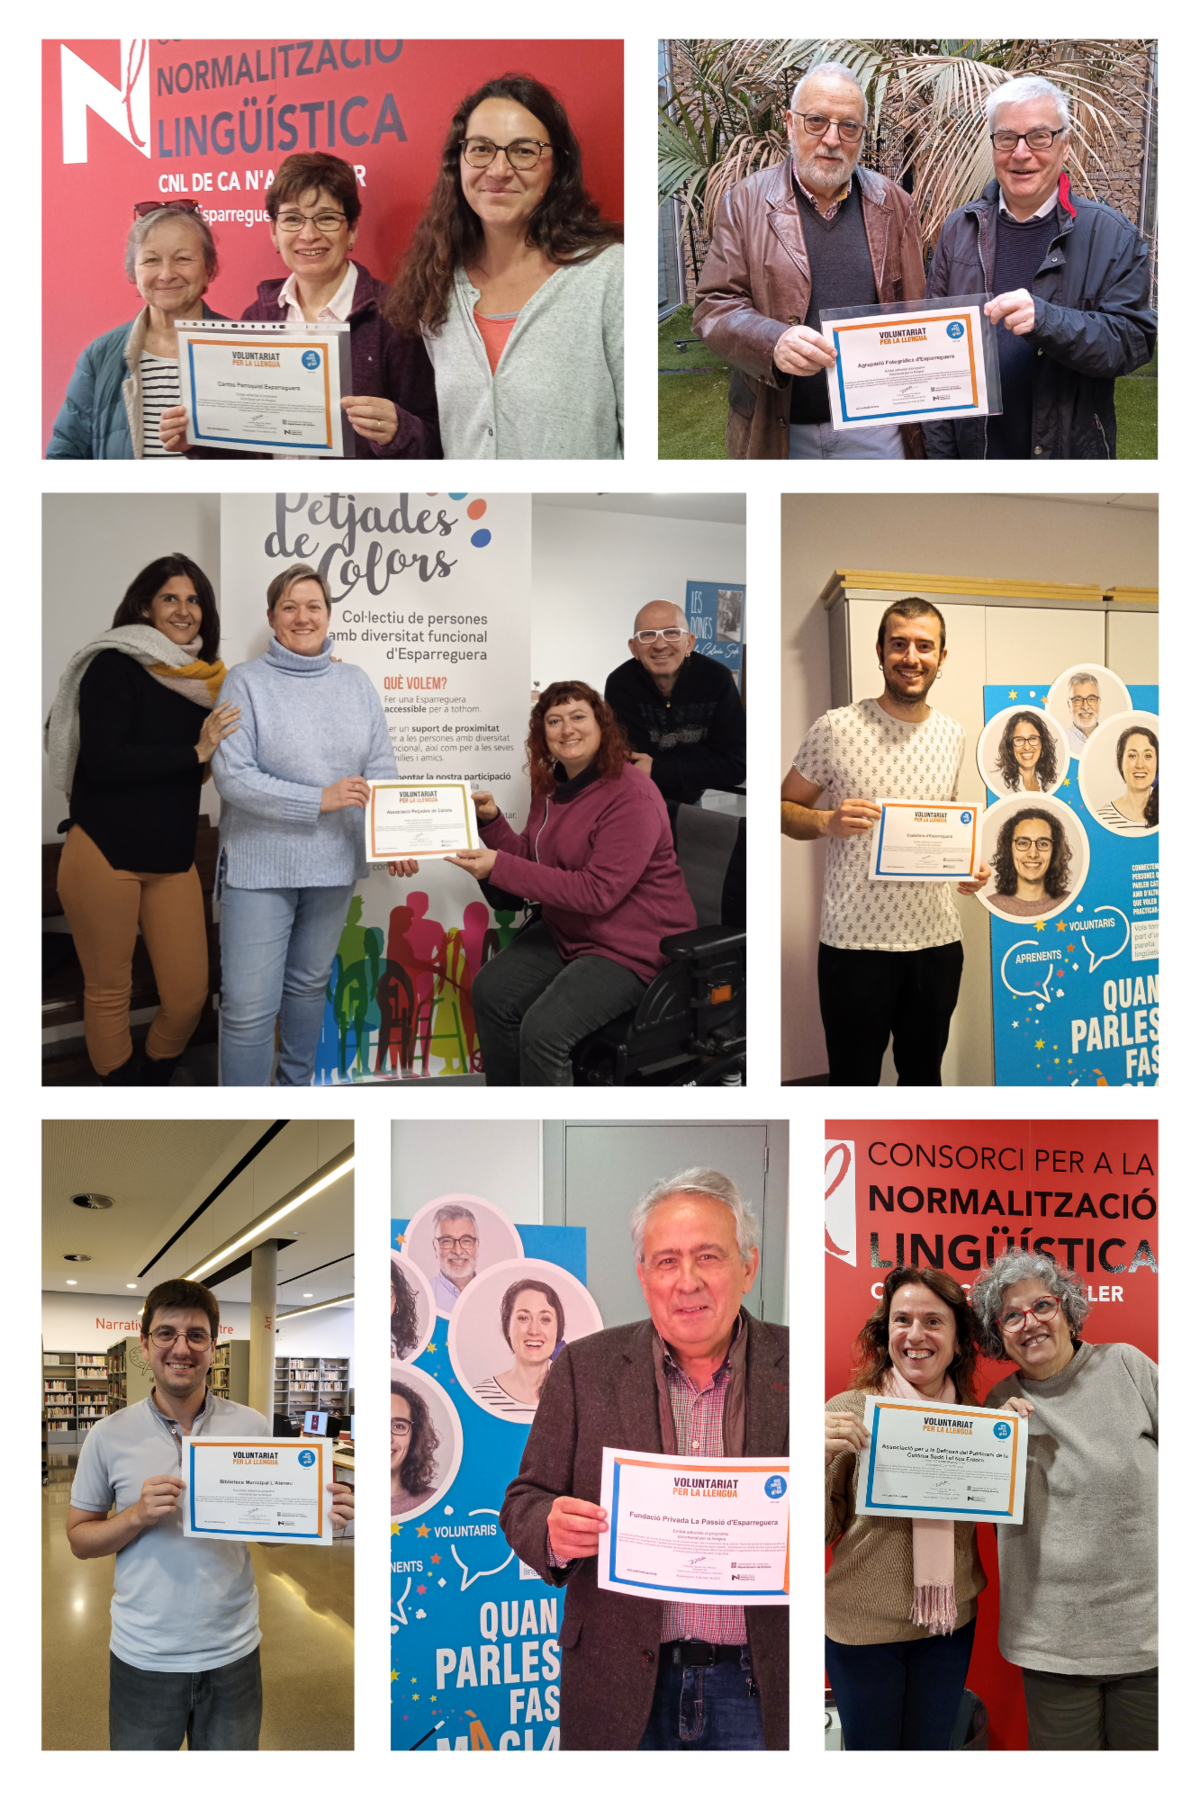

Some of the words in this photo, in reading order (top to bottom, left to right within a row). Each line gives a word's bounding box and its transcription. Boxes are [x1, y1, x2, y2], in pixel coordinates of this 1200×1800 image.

[158, 93, 408, 158] LINGÜÍSTICA
[158, 174, 188, 193] CNL
[192, 172, 213, 192] DE
[217, 171, 241, 192] CA
[879, 328, 927, 339] VOLUNTARIAT
[902, 335, 928, 343] LLENGUA
[232, 351, 280, 361] VOLUNTARIAT
[264, 531, 319, 559] de
[314, 541, 458, 603] Colors
[342, 610, 404, 625] Col·lectiu
[408, 612, 424, 624] de
[428, 613, 488, 628] persones
[328, 630, 357, 642] amb
[361, 630, 424, 643] diversitat
[428, 631, 488, 643] funcional
[386, 648, 488, 664] d'Esparreguera
[384, 675, 404, 690] QUÈ
[407, 677, 448, 690] VOLEM?
[384, 695, 396, 703] Fer
[416, 696, 467, 705] Esparreguera
[384, 705, 427, 713] accessible
[451, 705, 482, 713] tothom.
[411, 725, 440, 735] suport
[442, 725, 453, 733] de
[455, 725, 500, 735] proximitat
[406, 734, 417, 742] les
[419, 736, 454, 744] persones
[456, 734, 473, 742] amb
[475, 733, 510, 742] diversitat
[425, 744, 439, 752] així
[459, 746, 472, 754] per
[464, 772, 512, 781] participació
[1132, 872, 1155, 880] PERSONES
[1132, 881, 1150, 889] PARLEN
[1133, 899, 1142, 907] QUE
[1143, 898, 1157, 906] VOLEN
[1069, 918, 1115, 932] VOLUNTARIS
[1134, 933, 1146, 941] part
[1134, 941, 1155, 950] parella
[1015, 950, 1062, 964] APRENENTS
[1071, 1007, 1159, 1054] PARLES
[1126, 1044, 1159, 1079] FAS
[868, 1141, 1024, 1171] CONSORCI
[1035, 1149, 1084, 1174] PER
[1093, 1152, 1113, 1174] A
[1123, 1152, 1155, 1176] LA
[869, 1184, 1157, 1221] NORMALITZACIÓ
[264, 1315, 272, 1330] Art
[923, 1417, 974, 1429] VOLUNTARIAT
[673, 1477, 739, 1489] VOLUNTARIAT
[672, 1487, 689, 1496] PER
[690, 1488, 701, 1497] LA
[702, 1489, 738, 1498] LLENGUA
[629, 1511, 661, 1521] Fundació
[662, 1515, 690, 1524] Privada
[701, 1517, 726, 1526] Passió
[726, 1519, 779, 1527] d'Esparreguera
[434, 1524, 497, 1538] VOLUNTARIS
[480, 1598, 558, 1643] QUAN
[436, 1639, 560, 1690] PARLES
[510, 1685, 560, 1725] FAS
